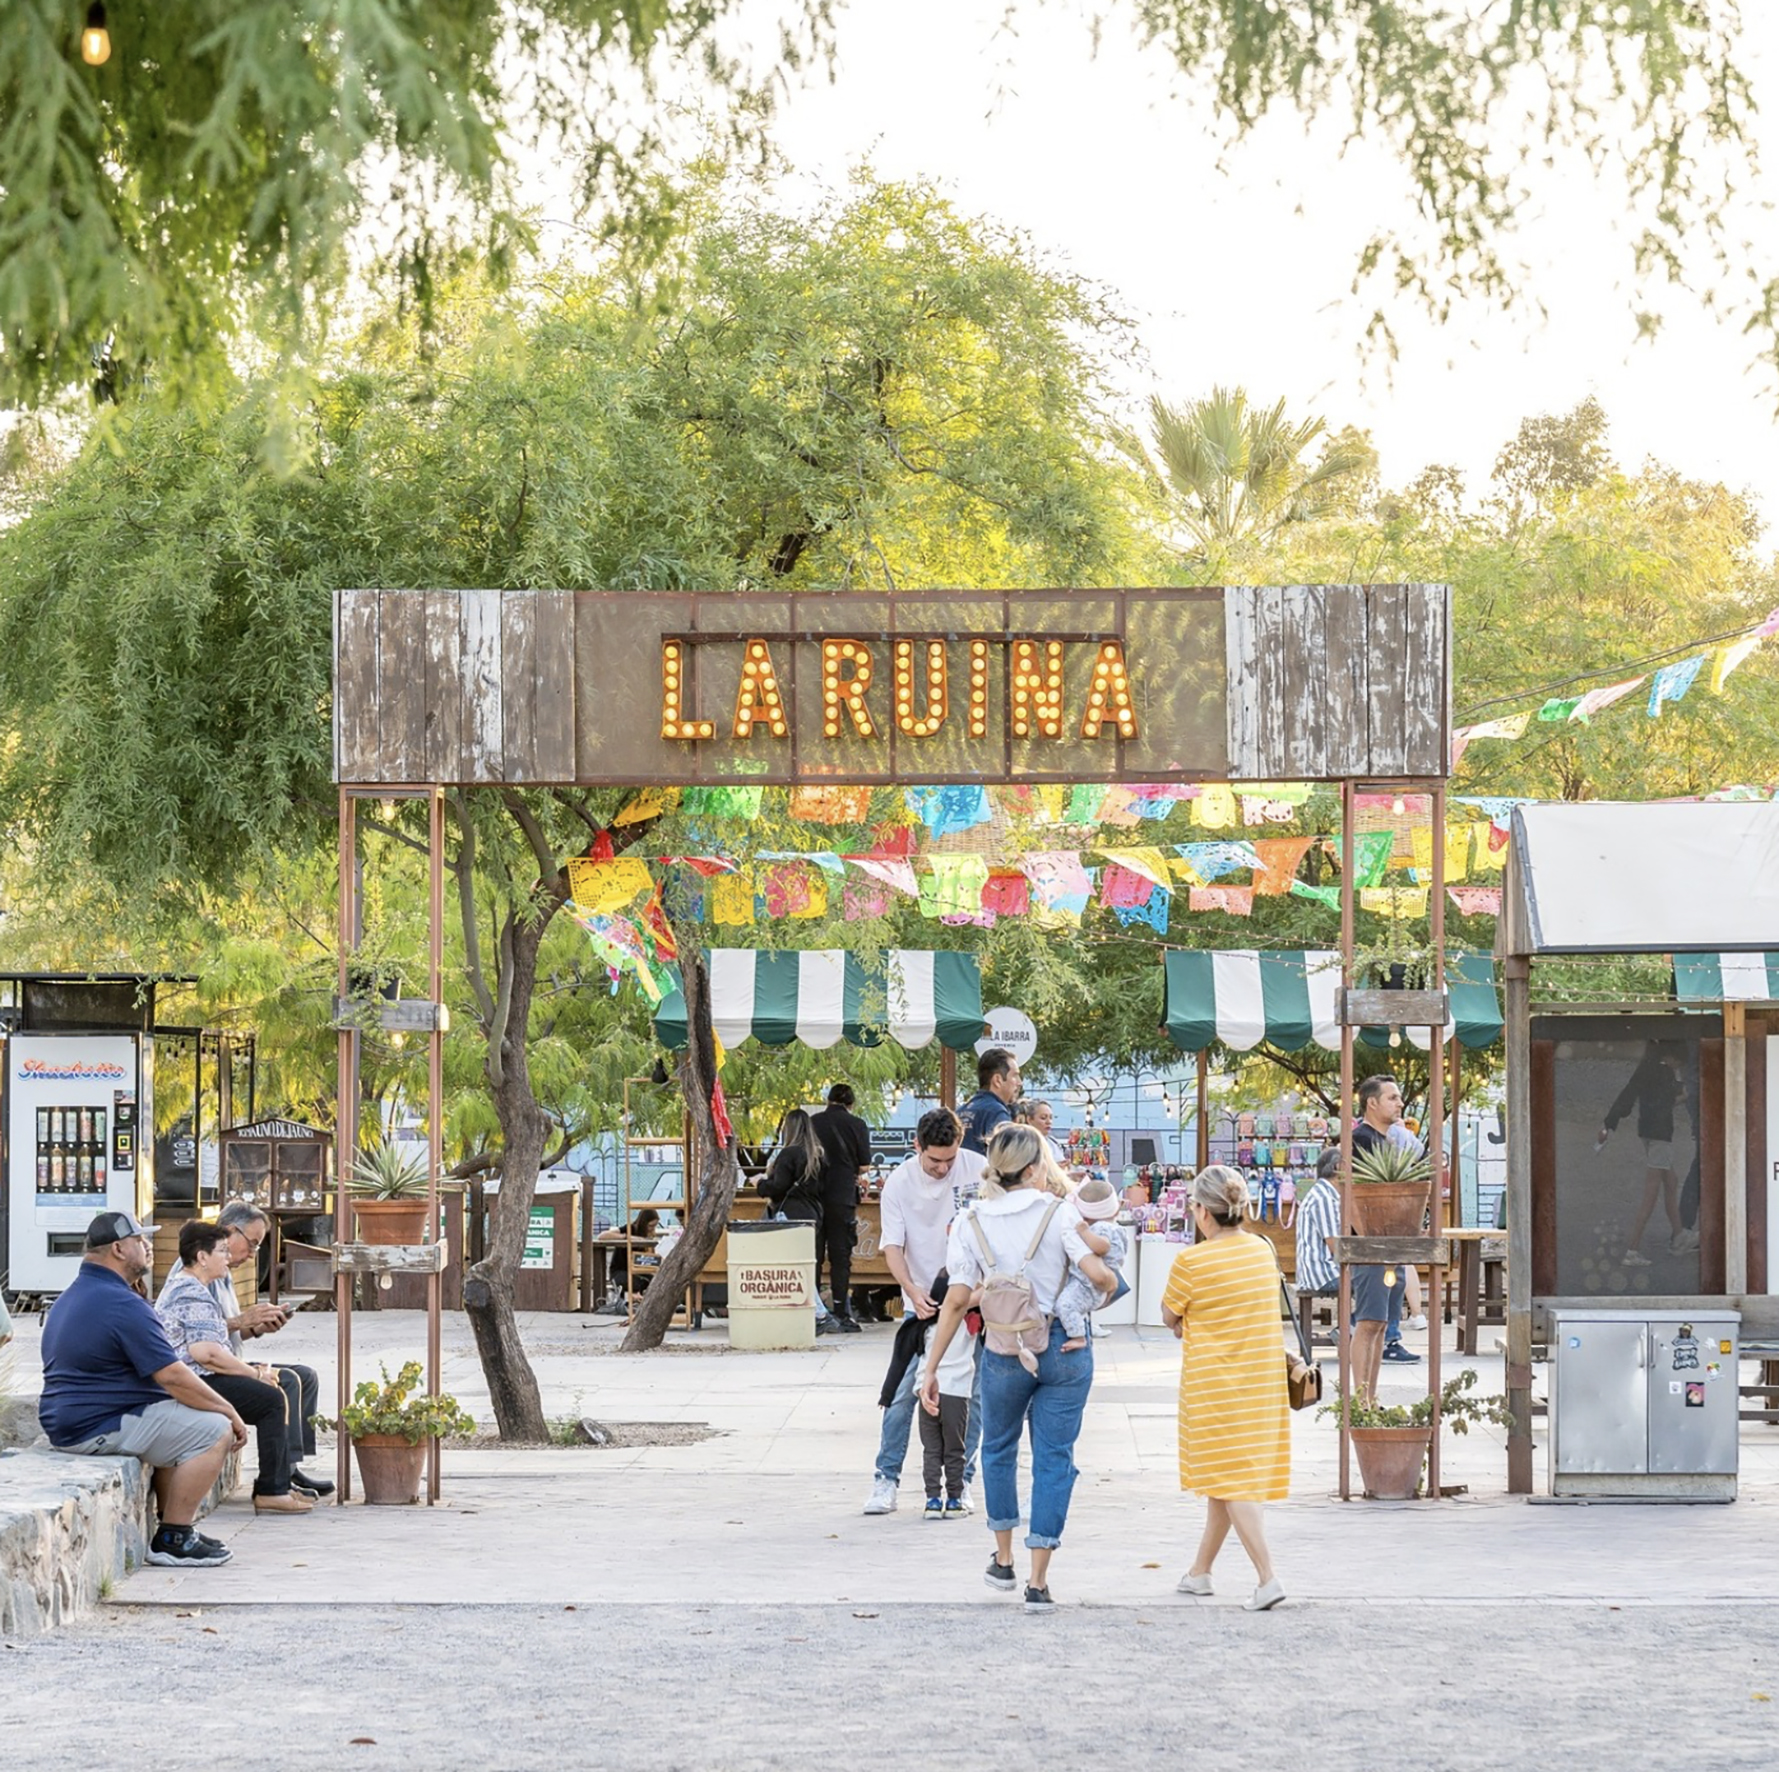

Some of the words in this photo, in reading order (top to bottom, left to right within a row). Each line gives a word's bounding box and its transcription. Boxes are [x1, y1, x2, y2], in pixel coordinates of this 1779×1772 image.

[660, 638, 791, 740] LA
[822, 637, 1139, 740] RUINA
[1001, 1030, 1031, 1042] IBARRA
[745, 1269, 797, 1281] BASURA
